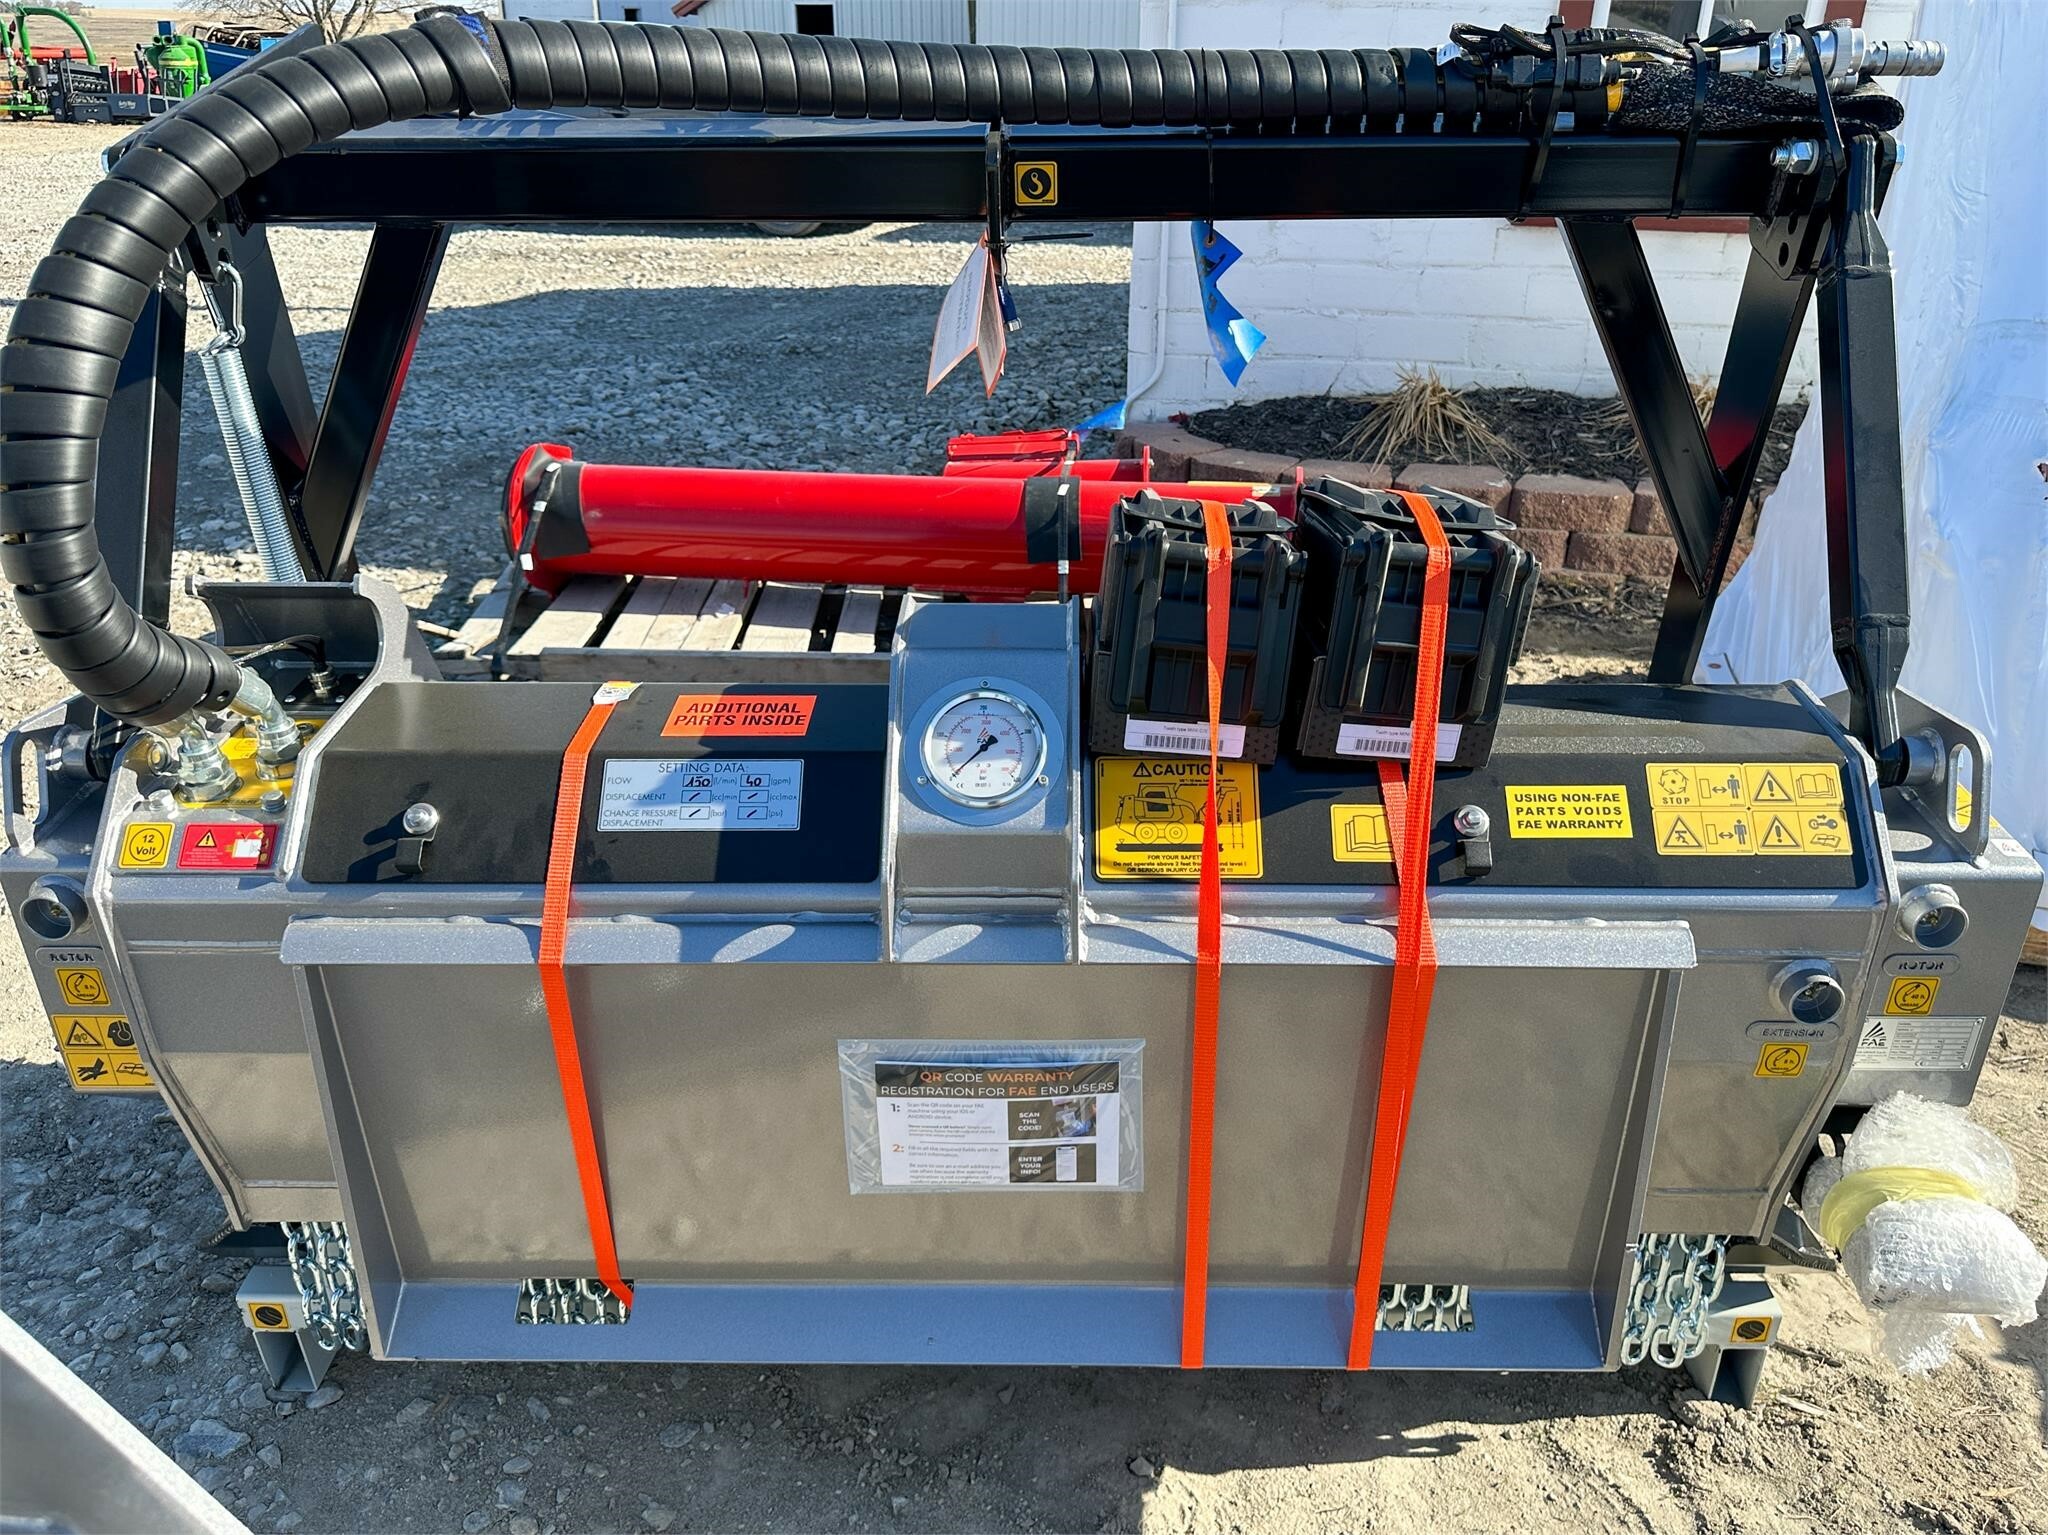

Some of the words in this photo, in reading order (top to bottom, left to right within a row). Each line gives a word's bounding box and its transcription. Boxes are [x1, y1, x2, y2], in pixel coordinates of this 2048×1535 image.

[686, 703, 801, 713] ADDITIONAL
[674, 715, 737, 725] PARTS
[741, 715, 807, 725] INSIDE
[658, 763, 710, 773] SETTING
[1152, 763, 1224, 776] CAUTION
[685, 775, 711, 787] 150
[1514, 794, 1557, 802] USING
[1562, 793, 1620, 802] NON-FAE
[603, 809, 640, 817] CHANGE
[641, 809, 678, 817] PRESSURE
[1516, 807, 1566, 815] PARTS
[1573, 807, 1622, 815] VOIDS
[602, 819, 664, 827] DISPLACEMENT
[1517, 820, 1542, 829] FAE
[1545, 820, 1623, 829] WARRANTY
[143, 834, 155, 843] 12
[136, 846, 156, 855] Volt
[1898, 961, 1945, 970] ROTOR
[1762, 1028, 1825, 1037] EXTENSION
[1861, 1038, 1887, 1046] FAE
[919, 1071, 942, 1083] QR
[945, 1072, 983, 1083] CODE
[987, 1071, 1074, 1083] WARRANTY
[881, 1086, 975, 1097] REGISTRATION
[978, 1087, 1006, 1097] FOR
[1008, 1087, 1036, 1096] FAE
[1040, 1085, 1069, 1095] END
[1072, 1082, 1115, 1094] USERS
[891, 1103, 900, 1112] 1:
[892, 1143, 904, 1152] 2:
